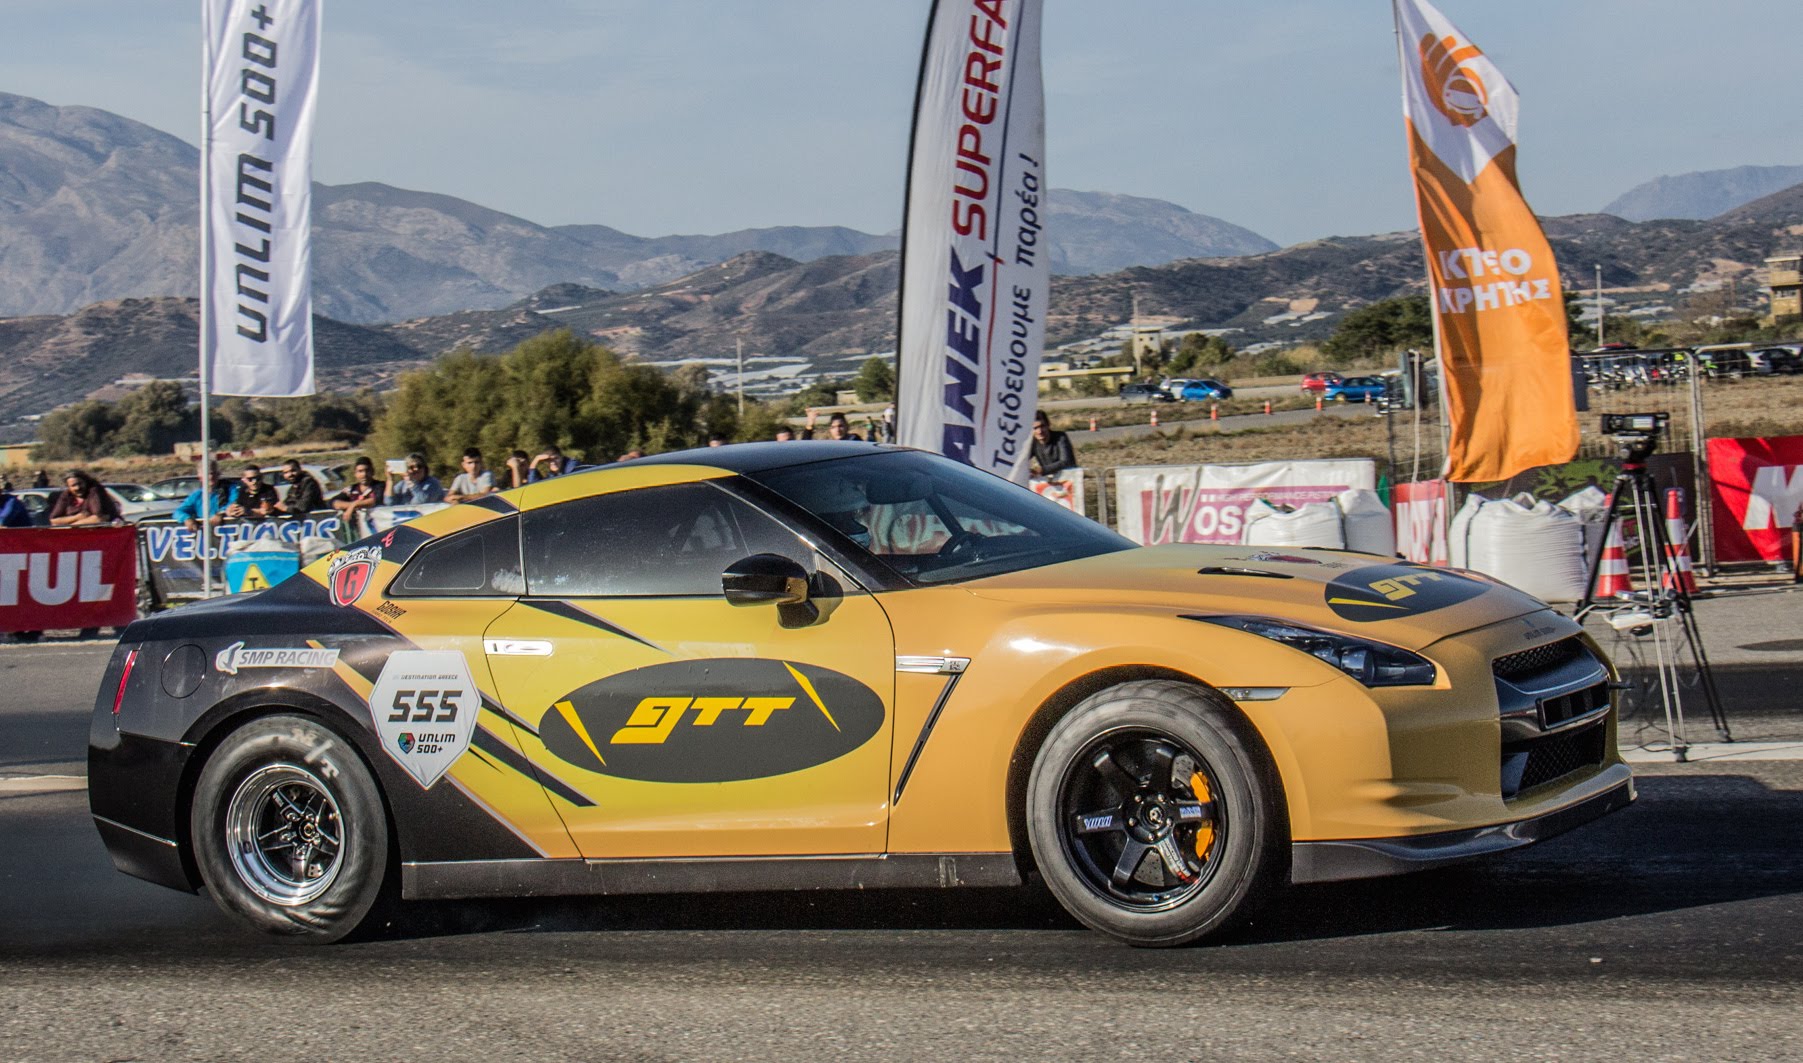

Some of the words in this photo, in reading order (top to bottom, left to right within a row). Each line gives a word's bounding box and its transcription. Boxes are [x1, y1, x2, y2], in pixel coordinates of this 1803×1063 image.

[239, 4, 278, 141] 500+
[234, 152, 274, 344] UNLIM
[942, 244, 985, 467] ANEK
[240, 650, 274, 665] SMP
[275, 651, 337, 666] RACING
[387, 690, 463, 723] 555
[416, 744, 443, 754] 500+
[418, 733, 456, 743] UNLIM
